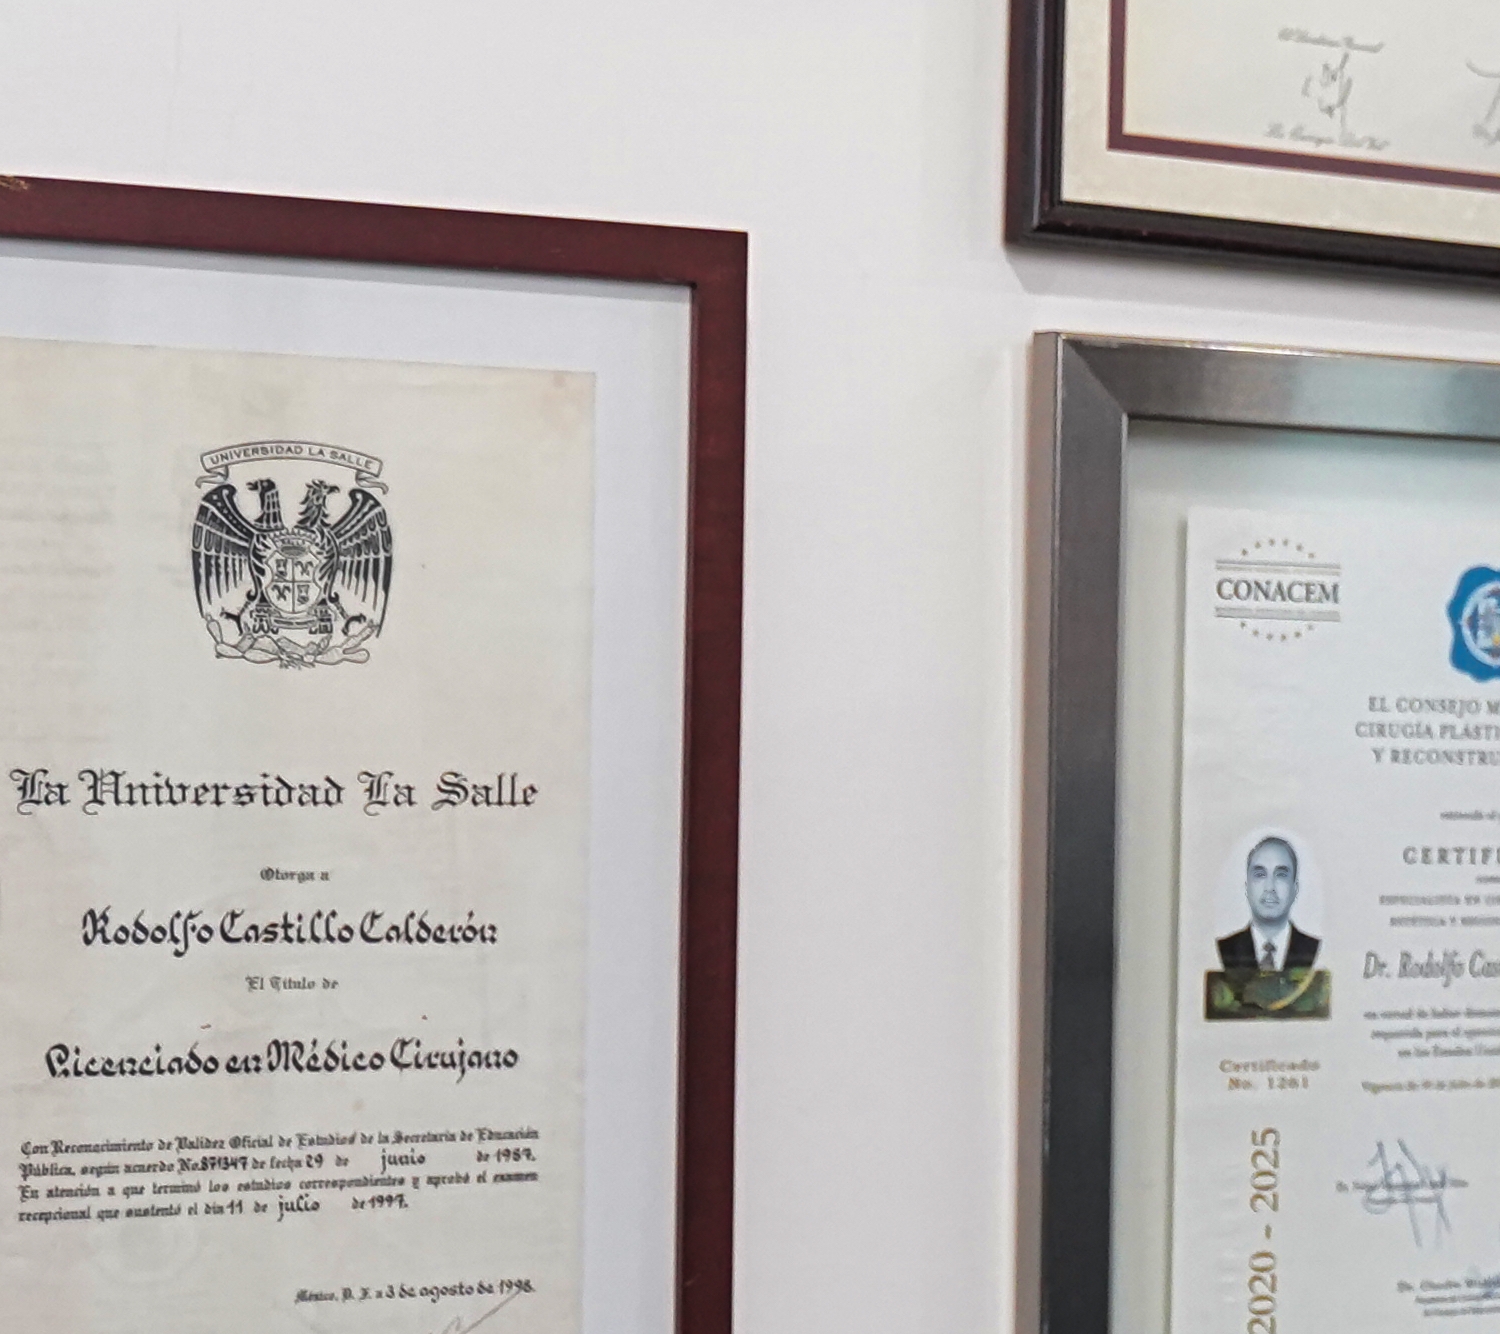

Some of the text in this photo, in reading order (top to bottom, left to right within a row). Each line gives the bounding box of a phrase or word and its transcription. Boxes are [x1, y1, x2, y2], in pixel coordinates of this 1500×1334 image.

[210, 441, 372, 469] UNIVERSIDAD LA SALLE
[1216, 577, 1340, 604] CONACEM
[1368, 696, 1391, 712] EL
[1396, 697, 1479, 718] CONSEJO
[1370, 748, 1383, 763] Y
[9, 767, 538, 818] La Universidad La Salle
[260, 867, 329, 883] Otorga a
[81, 906, 497, 957] Rodolfo Castillo Calderón
[245, 975, 339, 992] El de
[45, 1036, 518, 1084] Licenciado en Médico Cirujano
[20, 1130, 473, 1157] Con de Validez Oficial de de la de
[123, 1147, 489, 1174] acuerdo de 29 de junio de
[1249, 1127, 1280, 1213] 2025
[18, 1171, 486, 1201] En a que los el
[97, 1193, 365, 1221] que el 11 de julio de
[385, 1281, 474, 1303] 3 de agosto
